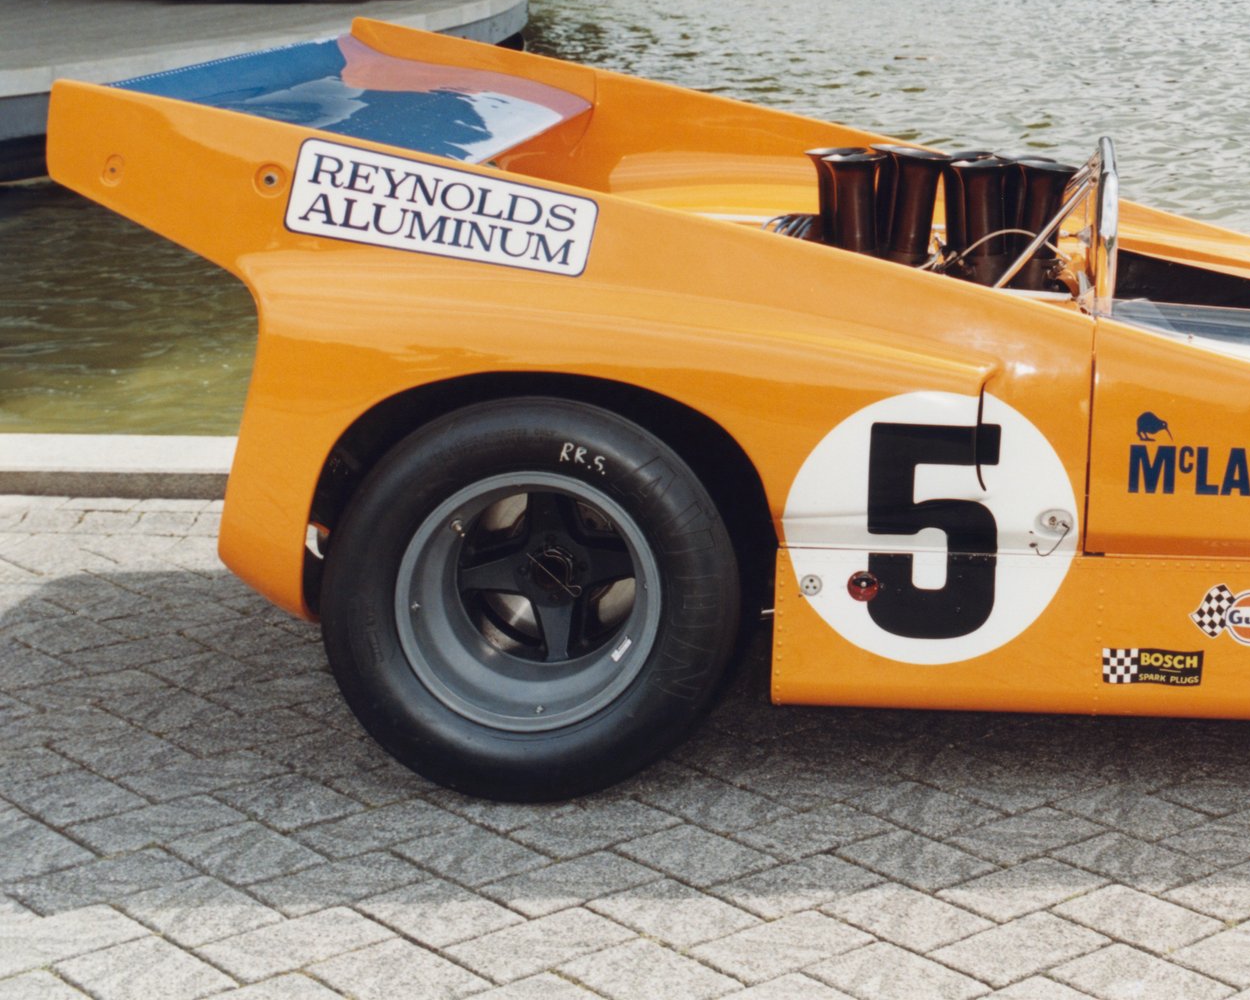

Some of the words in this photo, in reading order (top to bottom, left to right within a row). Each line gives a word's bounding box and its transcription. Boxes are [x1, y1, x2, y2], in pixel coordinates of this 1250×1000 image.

[297, 192, 576, 267] ALUMINUM
[307, 152, 578, 233] REYNOLDS
[866, 421, 1002, 640] 5
[1138, 673, 1167, 682] SPARK
[1169, 675, 1200, 685] PLUGS
[1140, 652, 1199, 669] BOSCH
